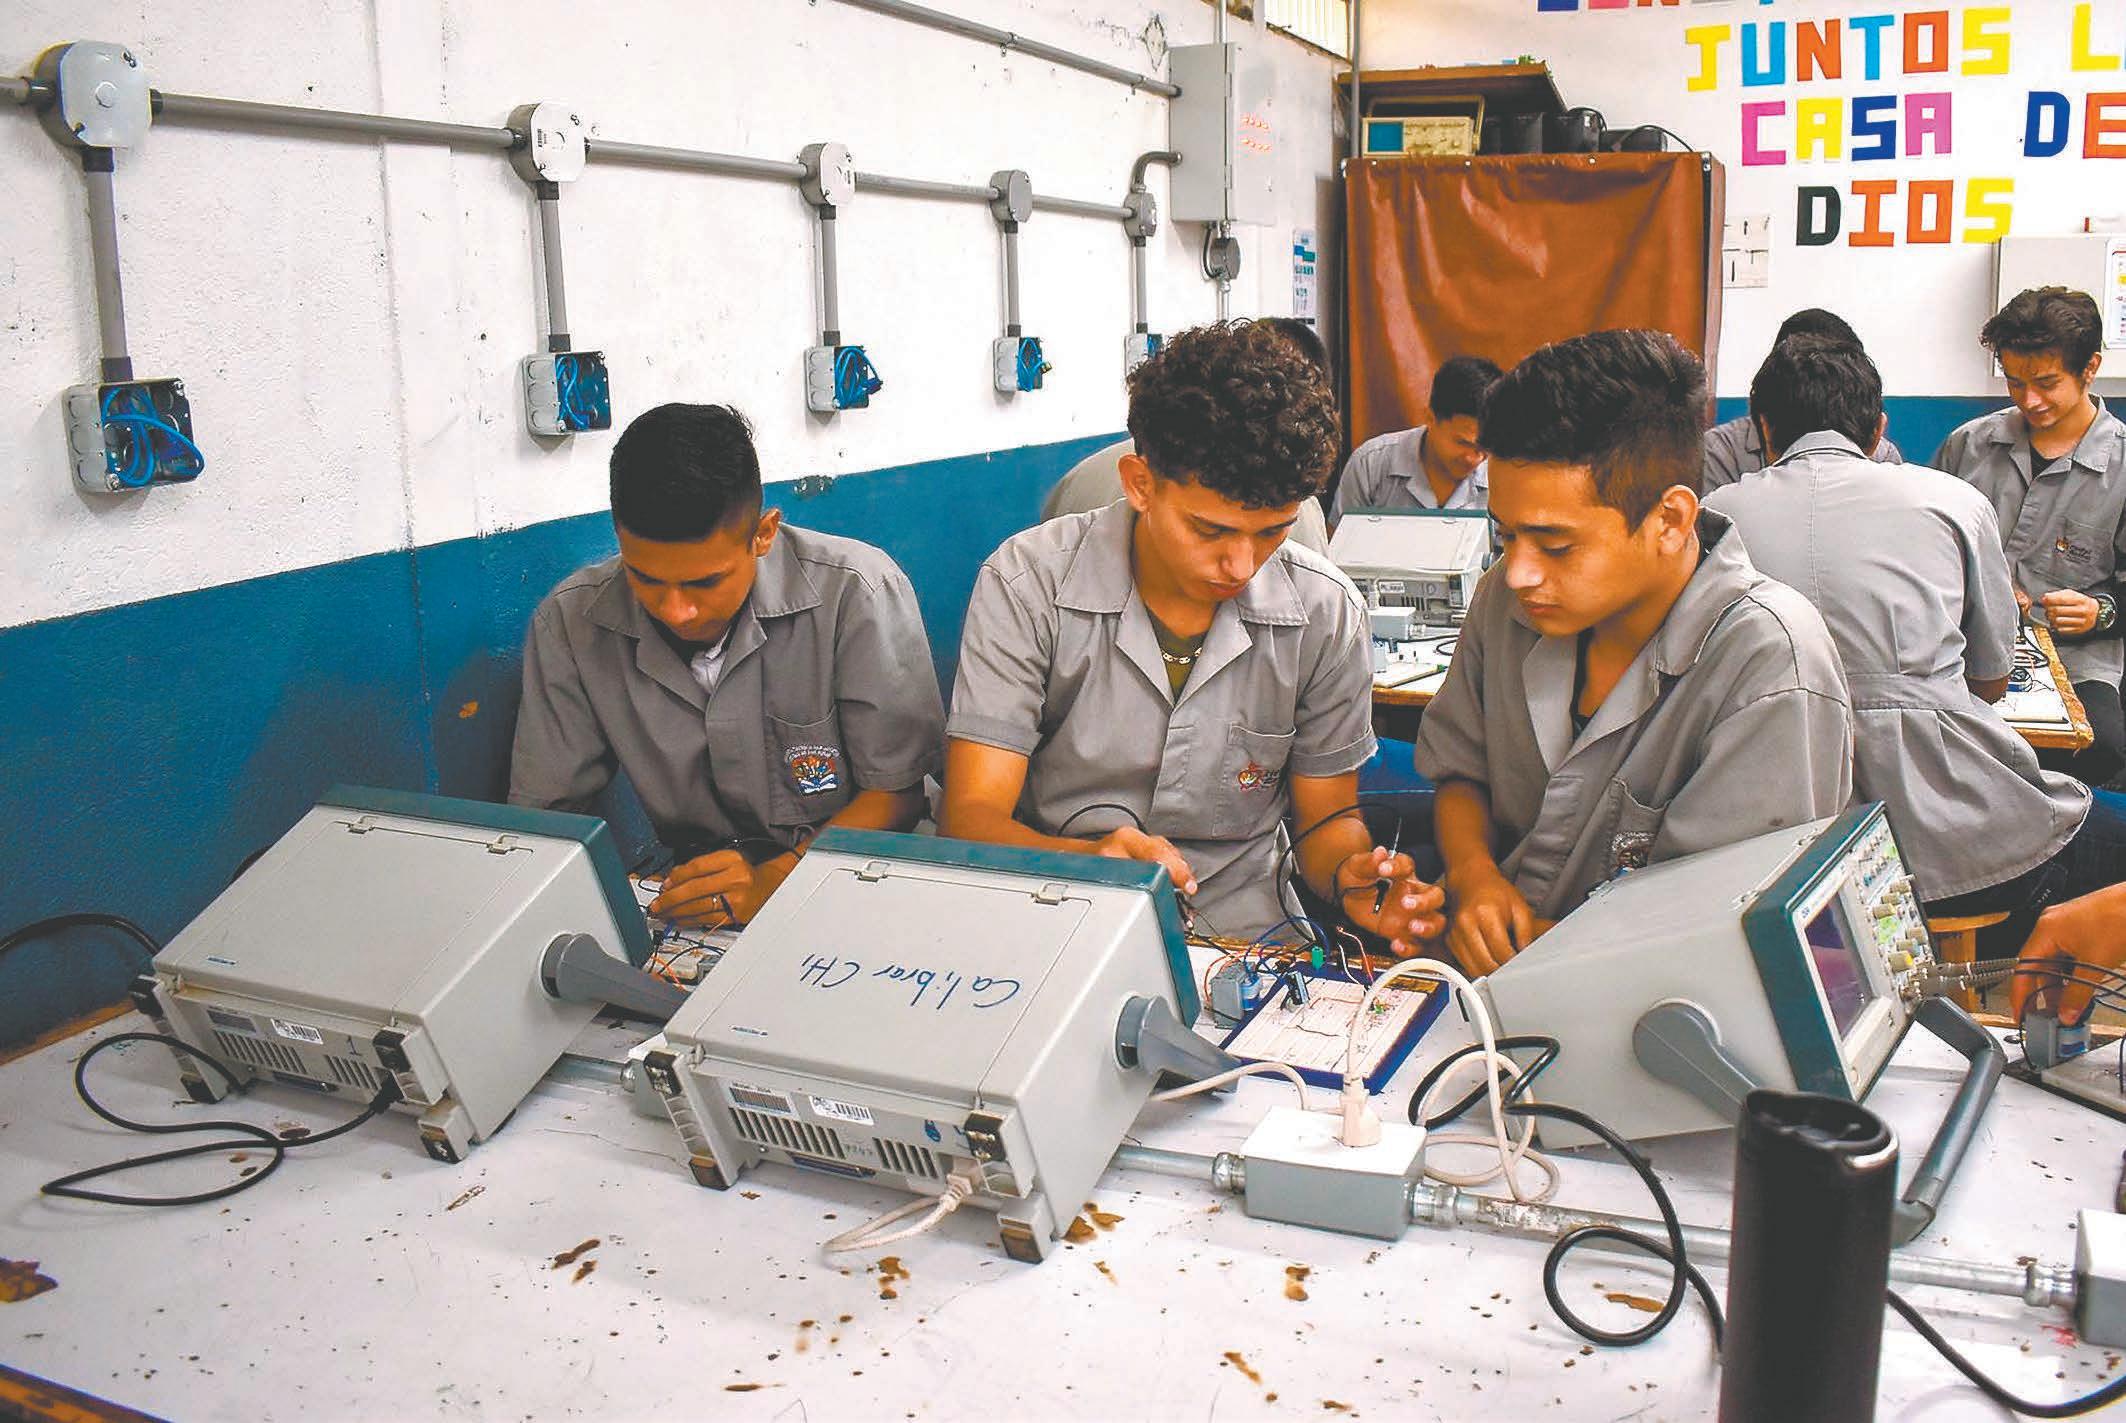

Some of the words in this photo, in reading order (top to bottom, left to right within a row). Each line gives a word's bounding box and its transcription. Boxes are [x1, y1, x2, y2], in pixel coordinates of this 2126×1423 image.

[1685, 7, 2011, 92] JUNTOS
[2072, 4, 2126, 71] L
[1742, 93, 1951, 166] CASA
[2024, 92, 2126, 159] DE
[1797, 178, 2014, 246] DIOS
[872, 965, 1020, 1009] Calibrar
